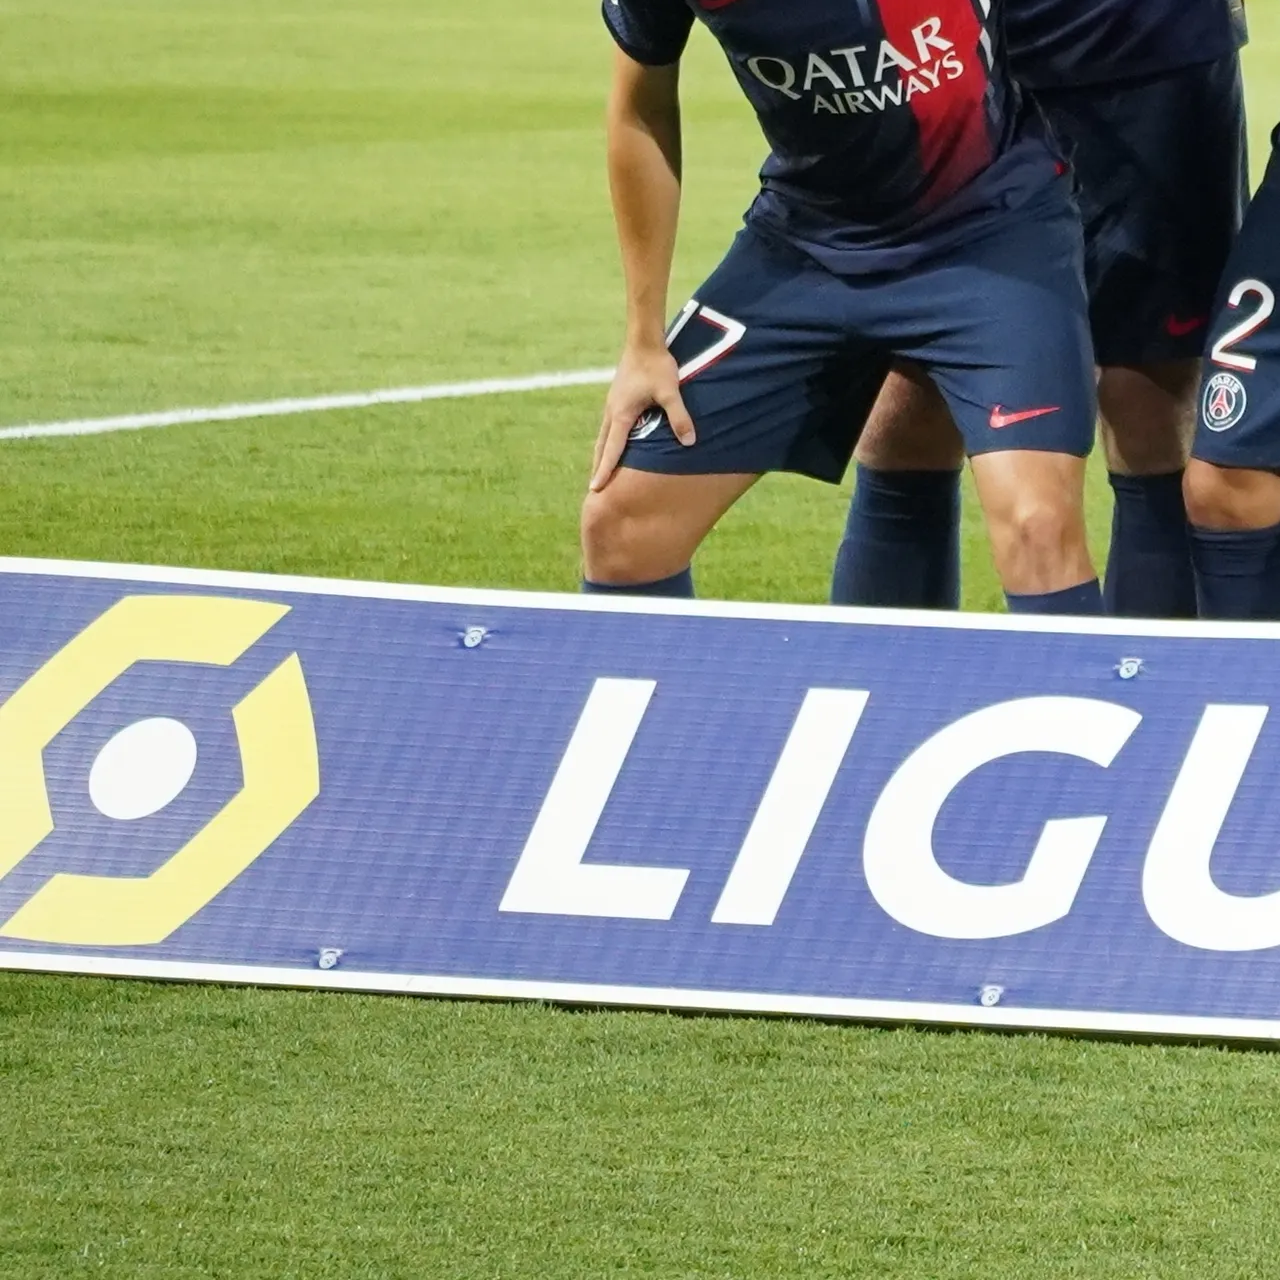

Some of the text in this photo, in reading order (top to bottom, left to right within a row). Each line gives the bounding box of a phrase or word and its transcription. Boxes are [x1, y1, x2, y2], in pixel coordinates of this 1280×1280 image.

[747, 16, 954, 101] QATAR
[812, 51, 965, 115] AIRWAYS
[1210, 278, 1275, 373] 2
[1210, 375, 1241, 394] PARIS
